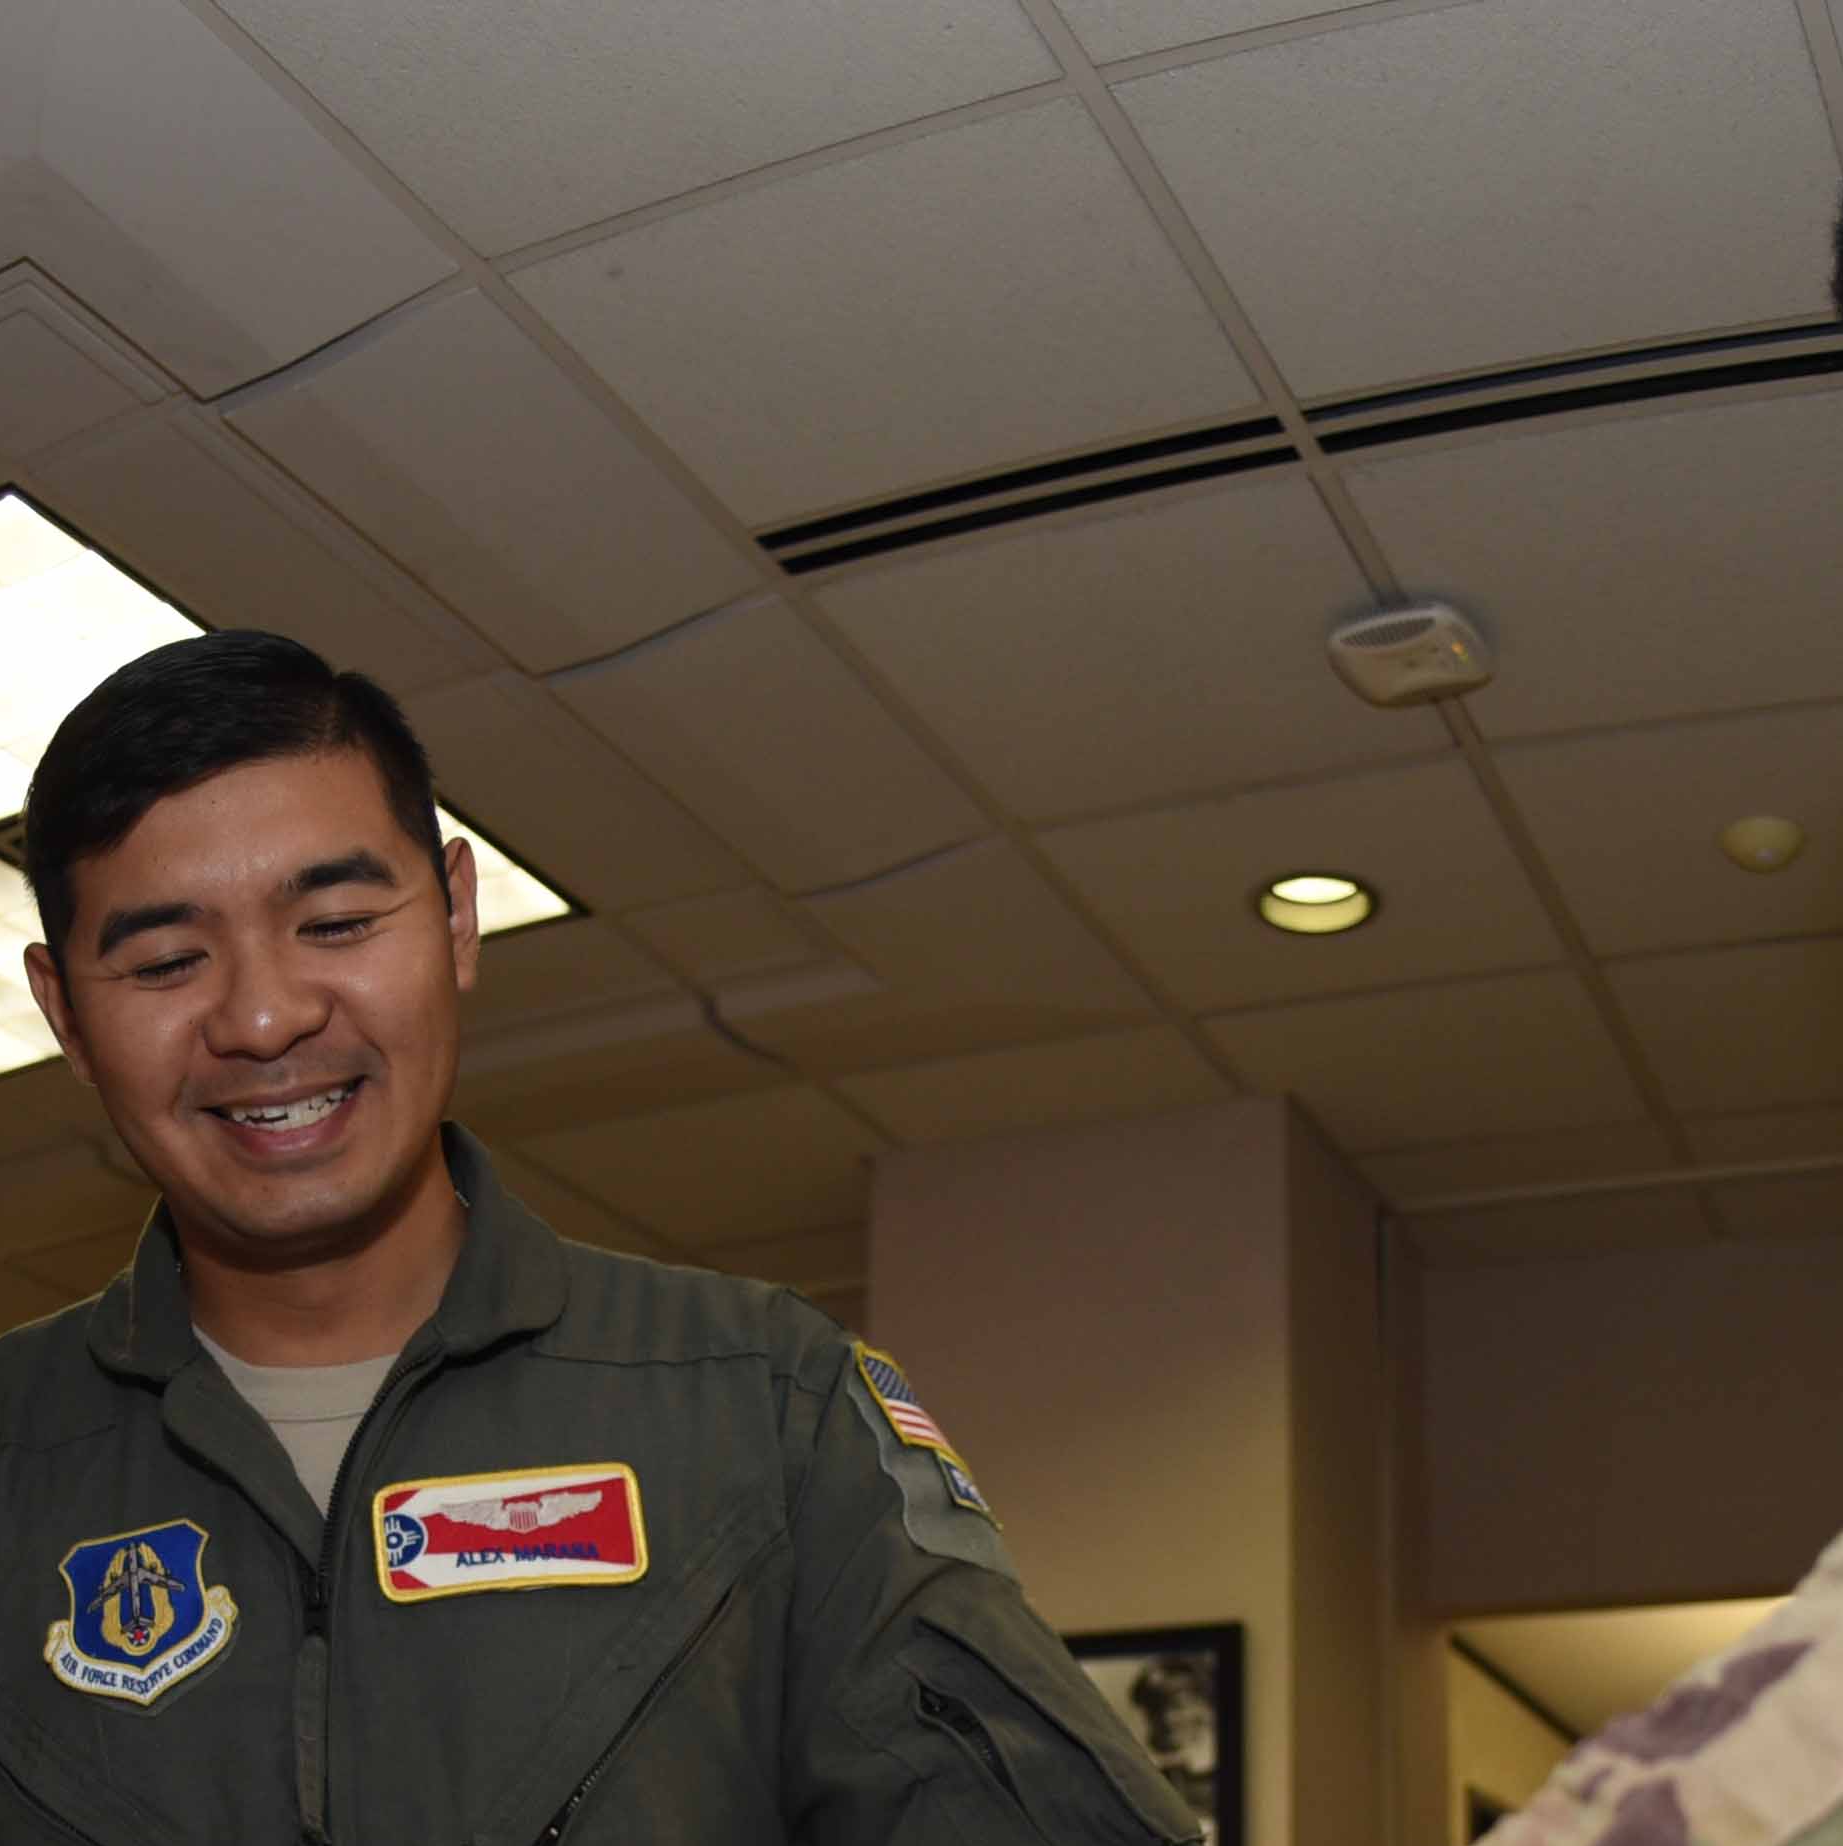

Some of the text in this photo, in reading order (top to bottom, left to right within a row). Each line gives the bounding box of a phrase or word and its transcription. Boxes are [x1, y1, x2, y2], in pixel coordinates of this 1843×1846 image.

[455, 1547, 505, 1568] ALEX
[60, 1617, 224, 1696] AIR FORCE RESERVE COMMAND
